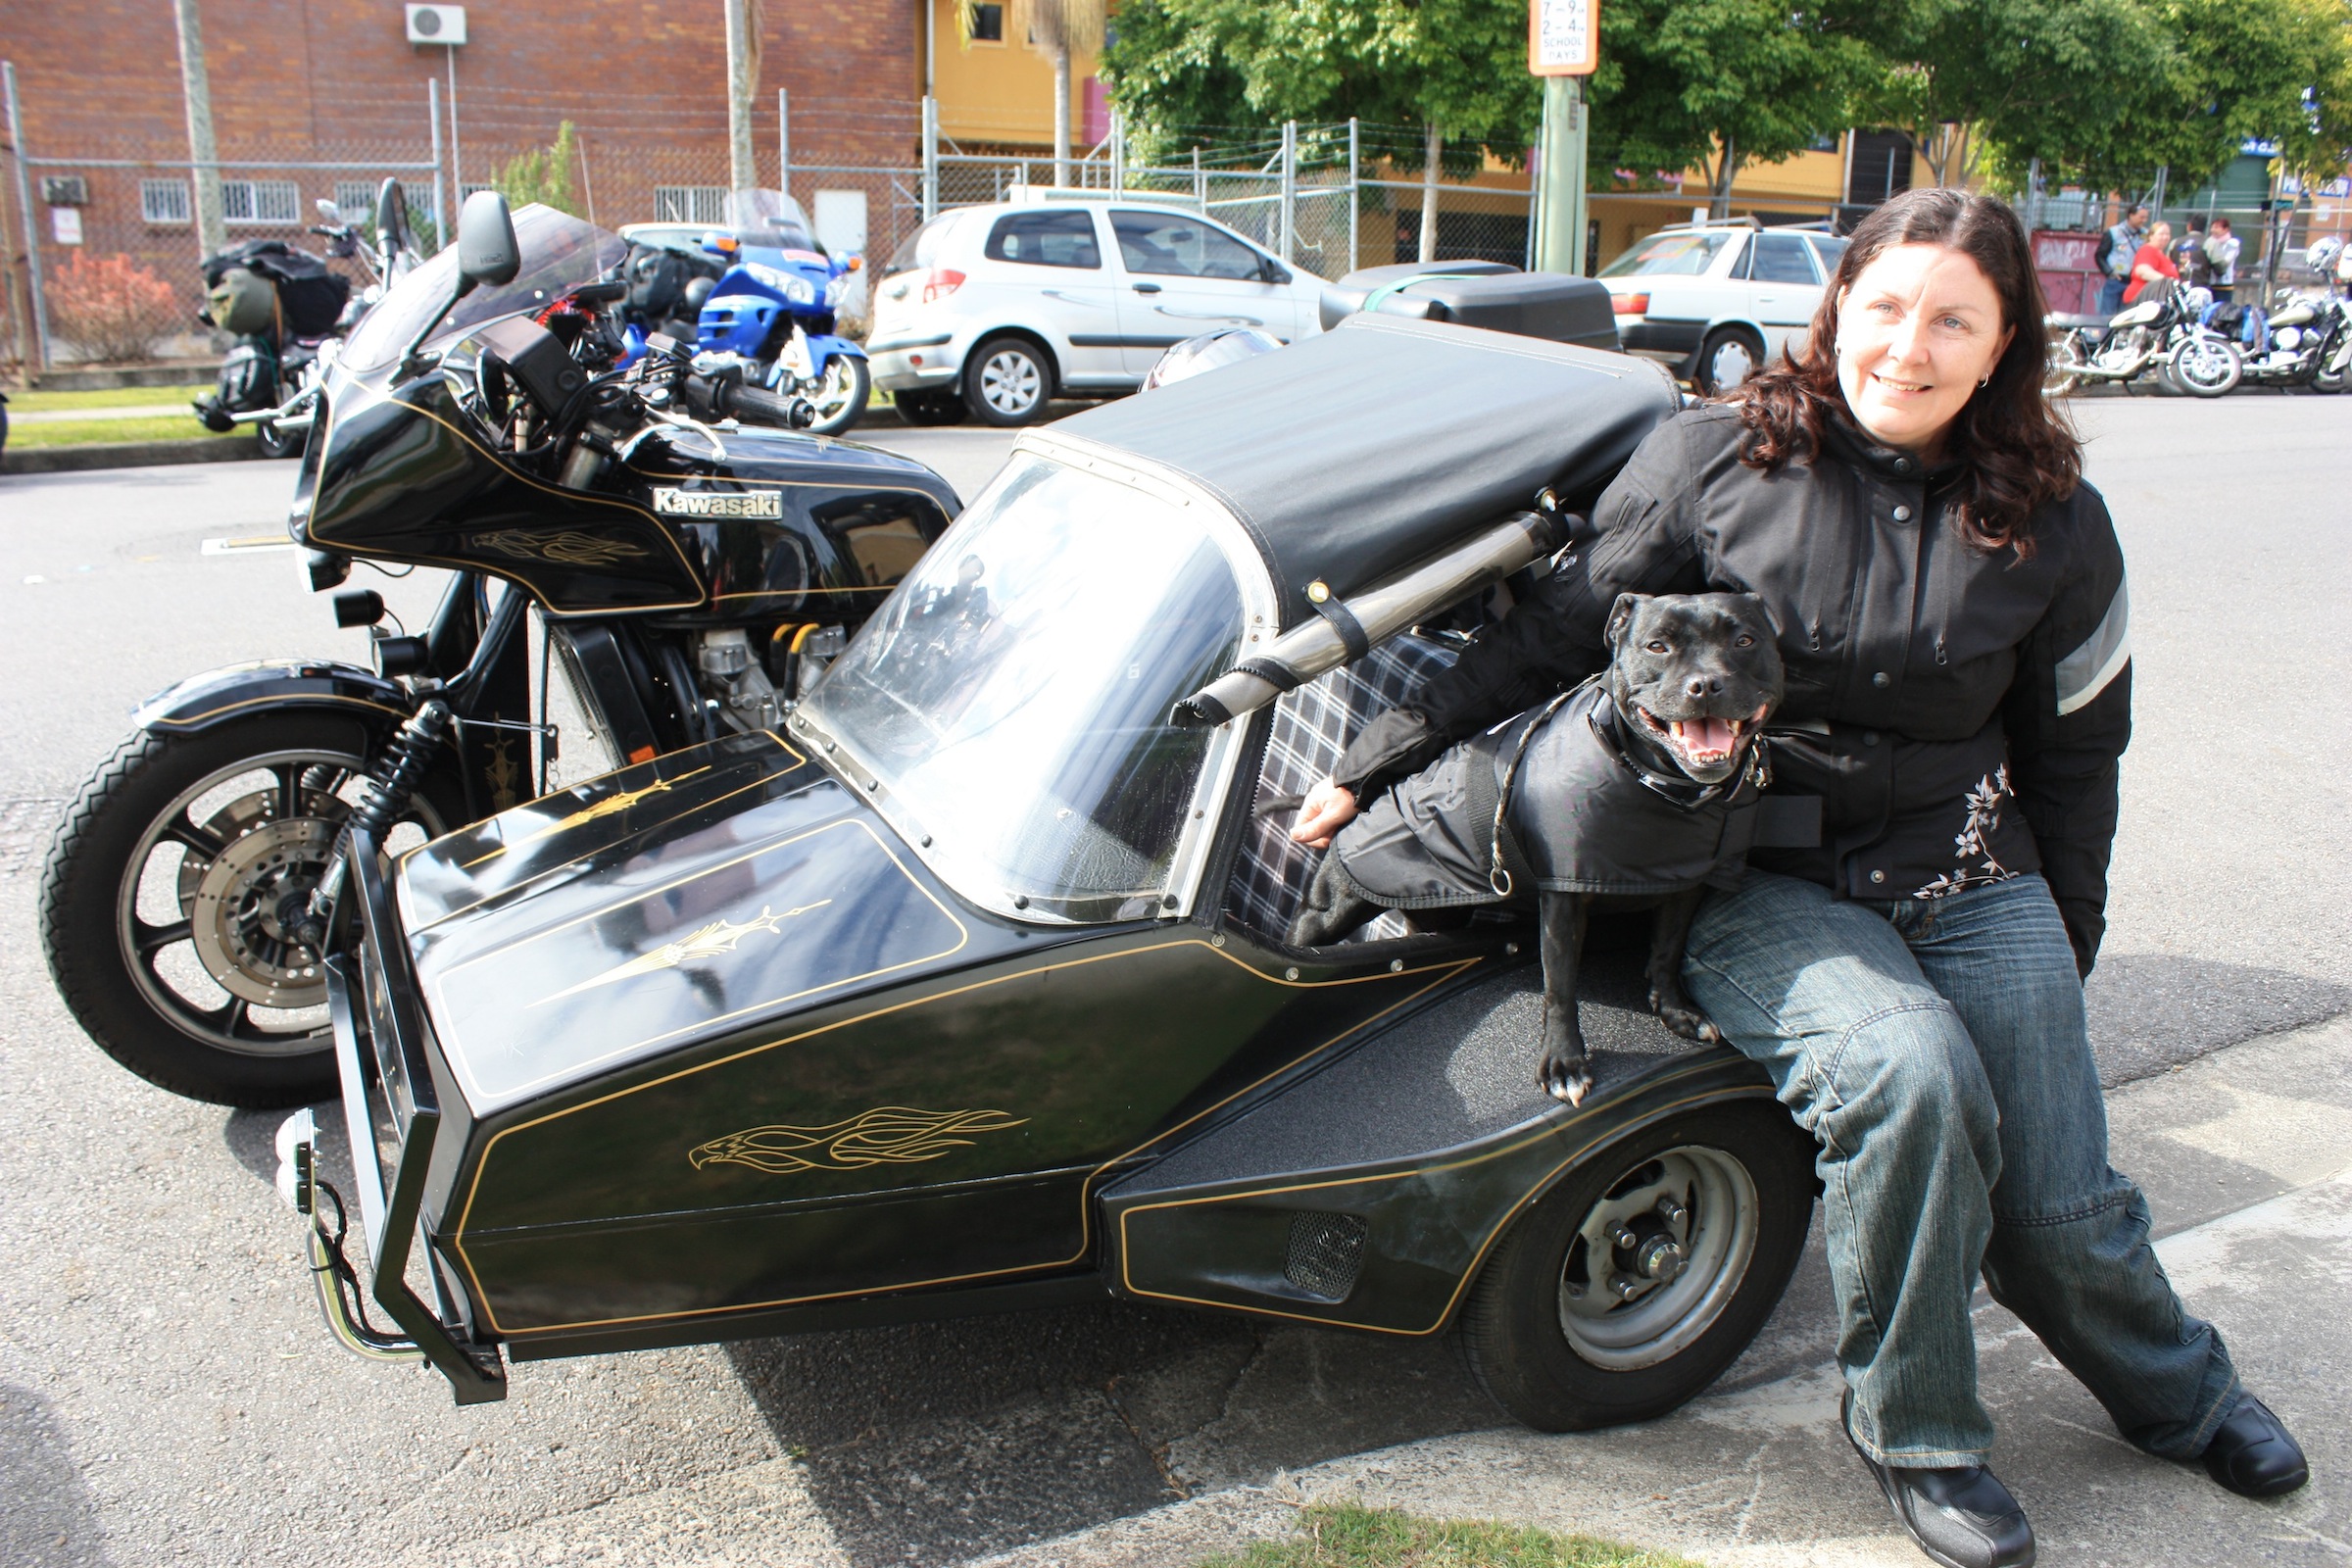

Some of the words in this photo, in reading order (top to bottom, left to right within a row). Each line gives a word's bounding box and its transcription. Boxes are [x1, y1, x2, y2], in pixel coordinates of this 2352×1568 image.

[1544, 1, 1550, 17] 7
[1543, 20, 1550, 35] 2
[1544, 36, 1583, 48] SCHOOL
[655, 490, 780, 516] Kawasaki
